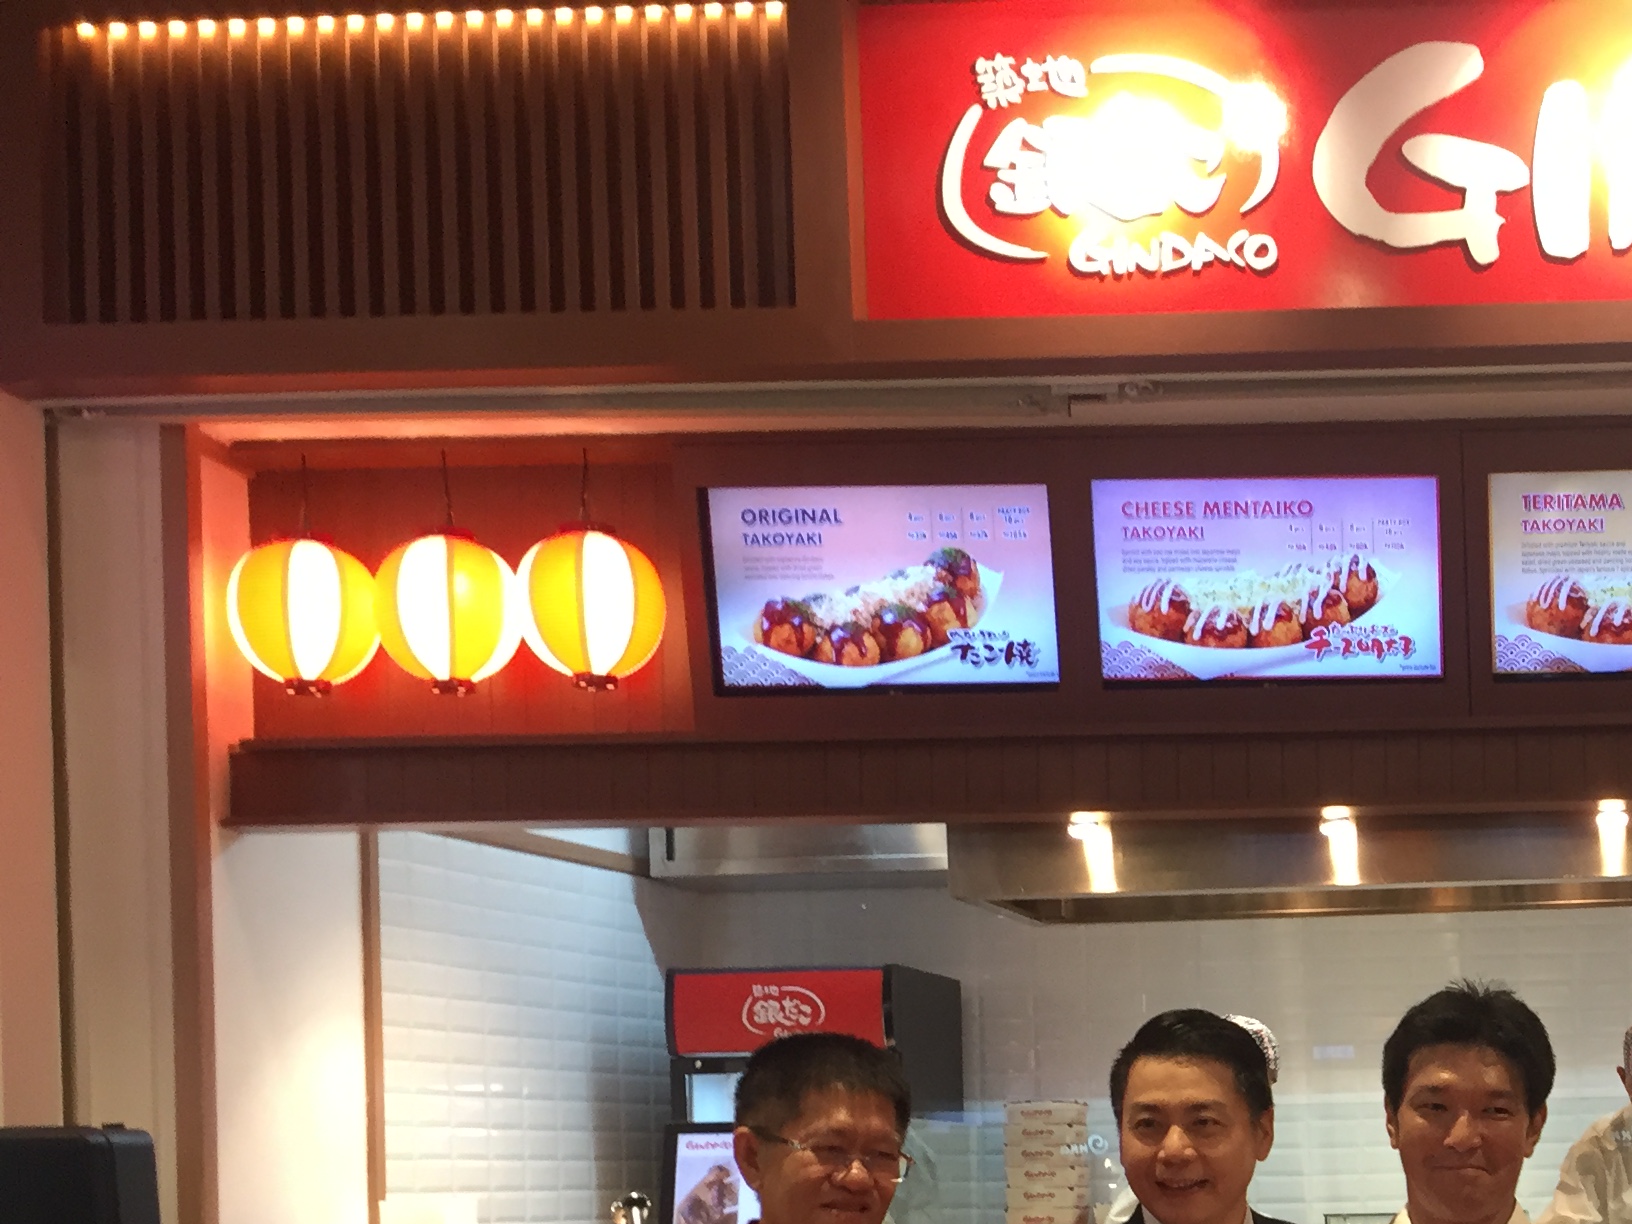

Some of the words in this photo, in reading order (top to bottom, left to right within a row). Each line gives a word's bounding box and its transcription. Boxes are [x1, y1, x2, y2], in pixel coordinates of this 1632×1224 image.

[976, 53, 1087, 109] 築地
[1068, 229, 1280, 277] GINDACO
[1121, 501, 1193, 518] CHEESE
[1203, 500, 1313, 518] MENTAIKO
[1522, 493, 1624, 511] TERITAMA
[741, 508, 843, 526] ORIGINAL
[1522, 519, 1605, 533] TAKOYAKI
[742, 532, 823, 546] TAKOYAKI
[1122, 526, 1205, 540] TAKOYAKI
[753, 996, 813, 1027] 銀だこ
